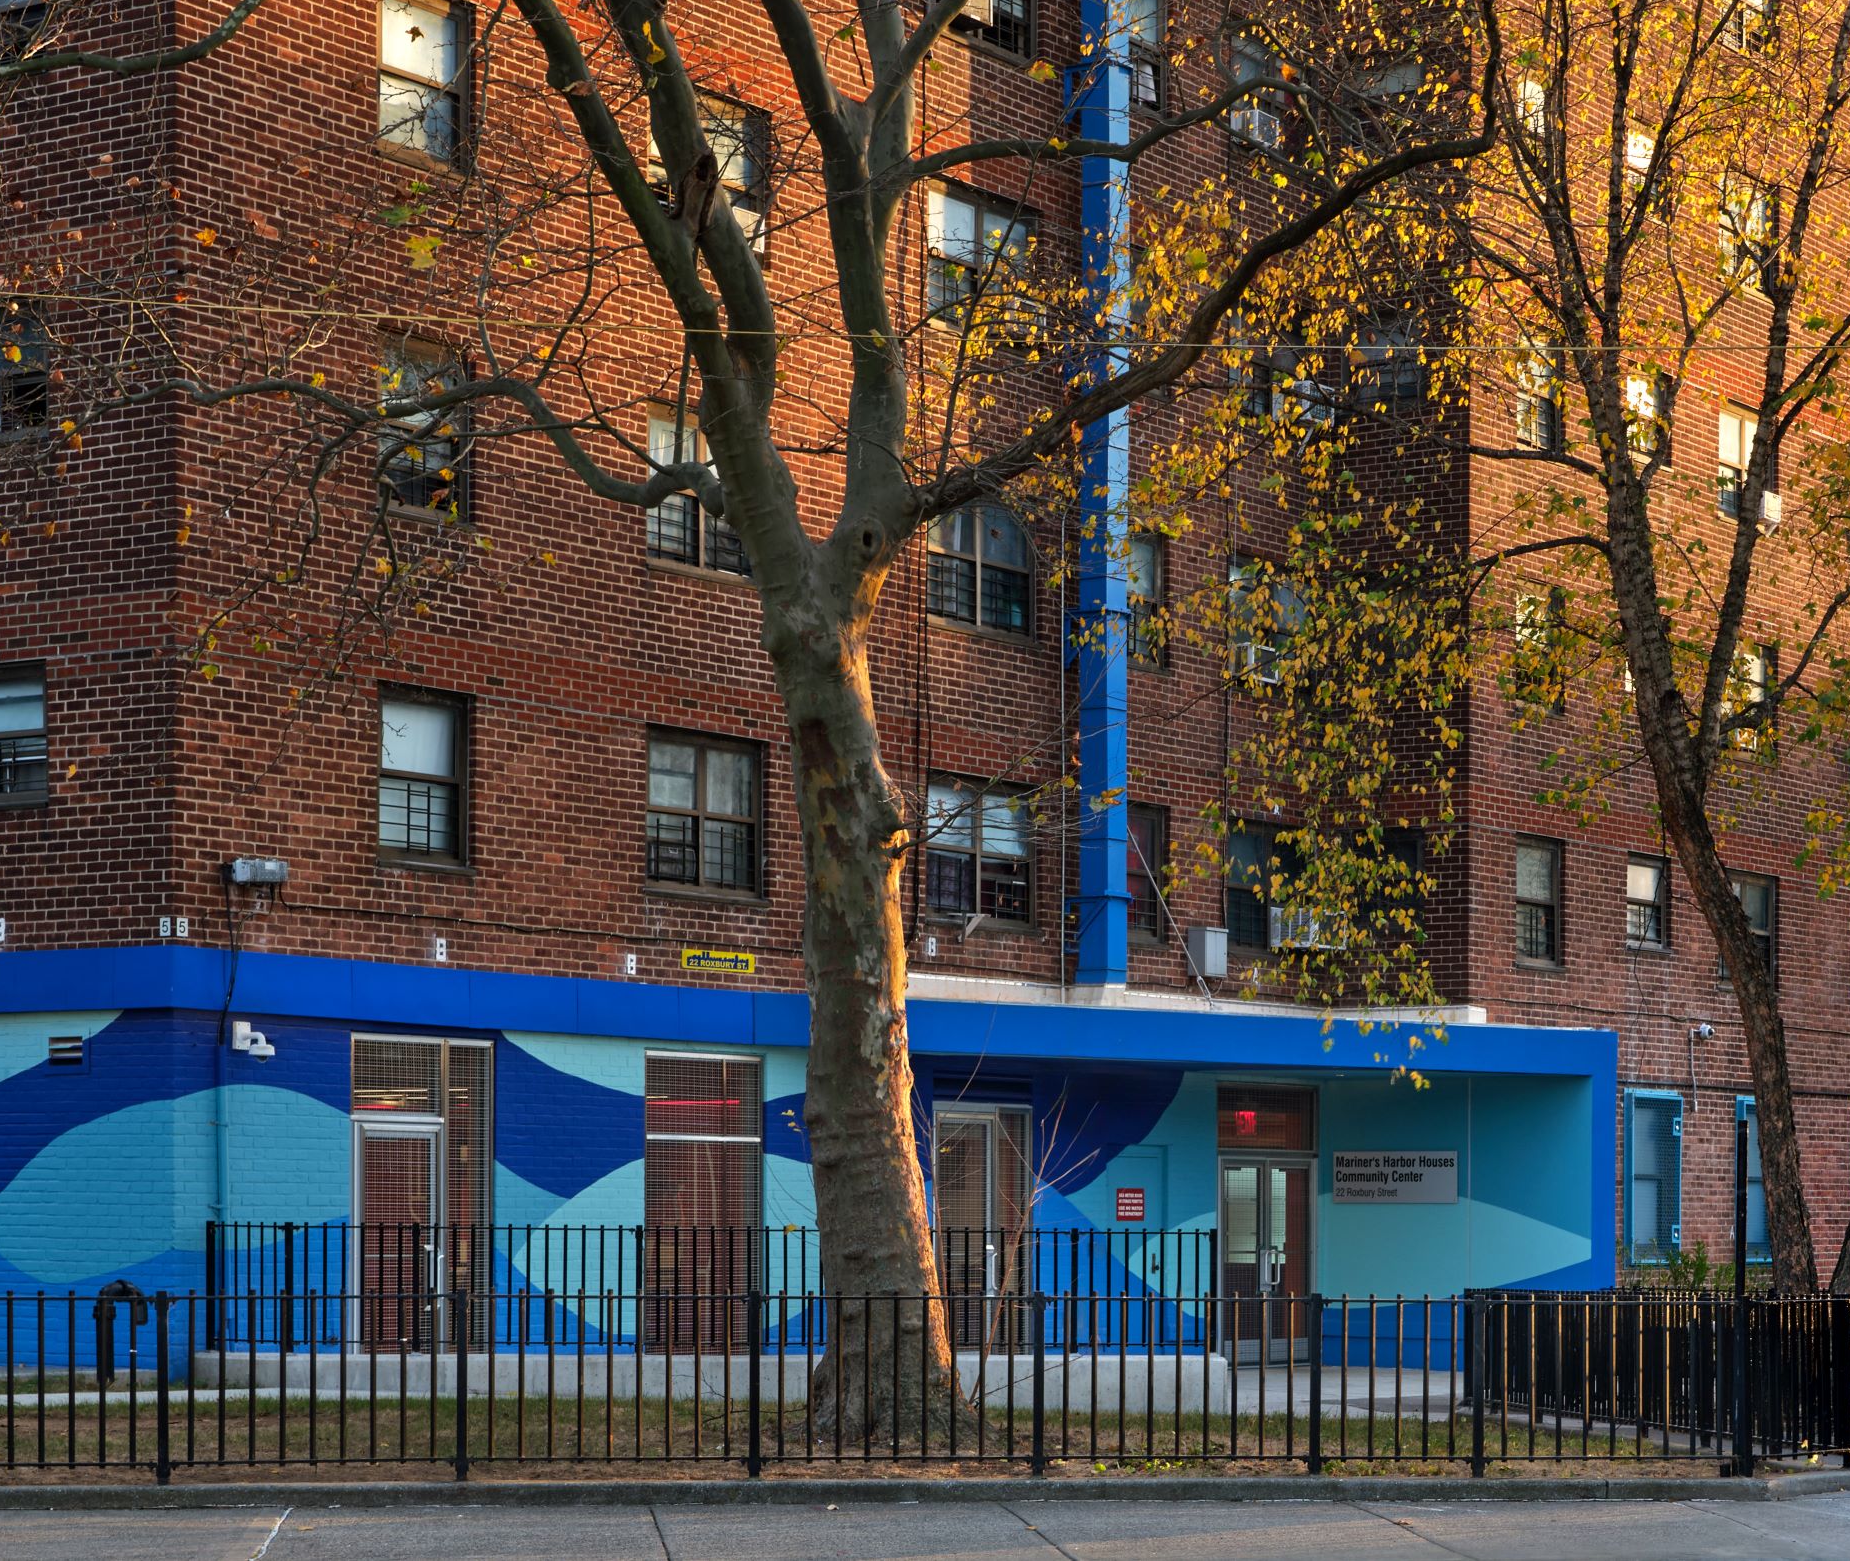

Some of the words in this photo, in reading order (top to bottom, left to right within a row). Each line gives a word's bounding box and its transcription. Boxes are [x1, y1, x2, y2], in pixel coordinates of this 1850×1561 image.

[162, 921, 169, 933] 5
[179, 921, 186, 933] 5
[436, 938, 446, 961] B
[689, 958, 698, 966] 22
[700, 959, 735, 968] ROXBURY
[1336, 1155, 1380, 1168] Mariner's
[1383, 1155, 1416, 1168] Harbor
[1419, 1155, 1454, 1168] Houses
[1336, 1170, 1389, 1185] Community
[1391, 1170, 1423, 1182] Center
[1336, 1188, 1345, 1197] 22
[1347, 1187, 1375, 1198] Roxbury
[1377, 1187, 1398, 1197] Street
